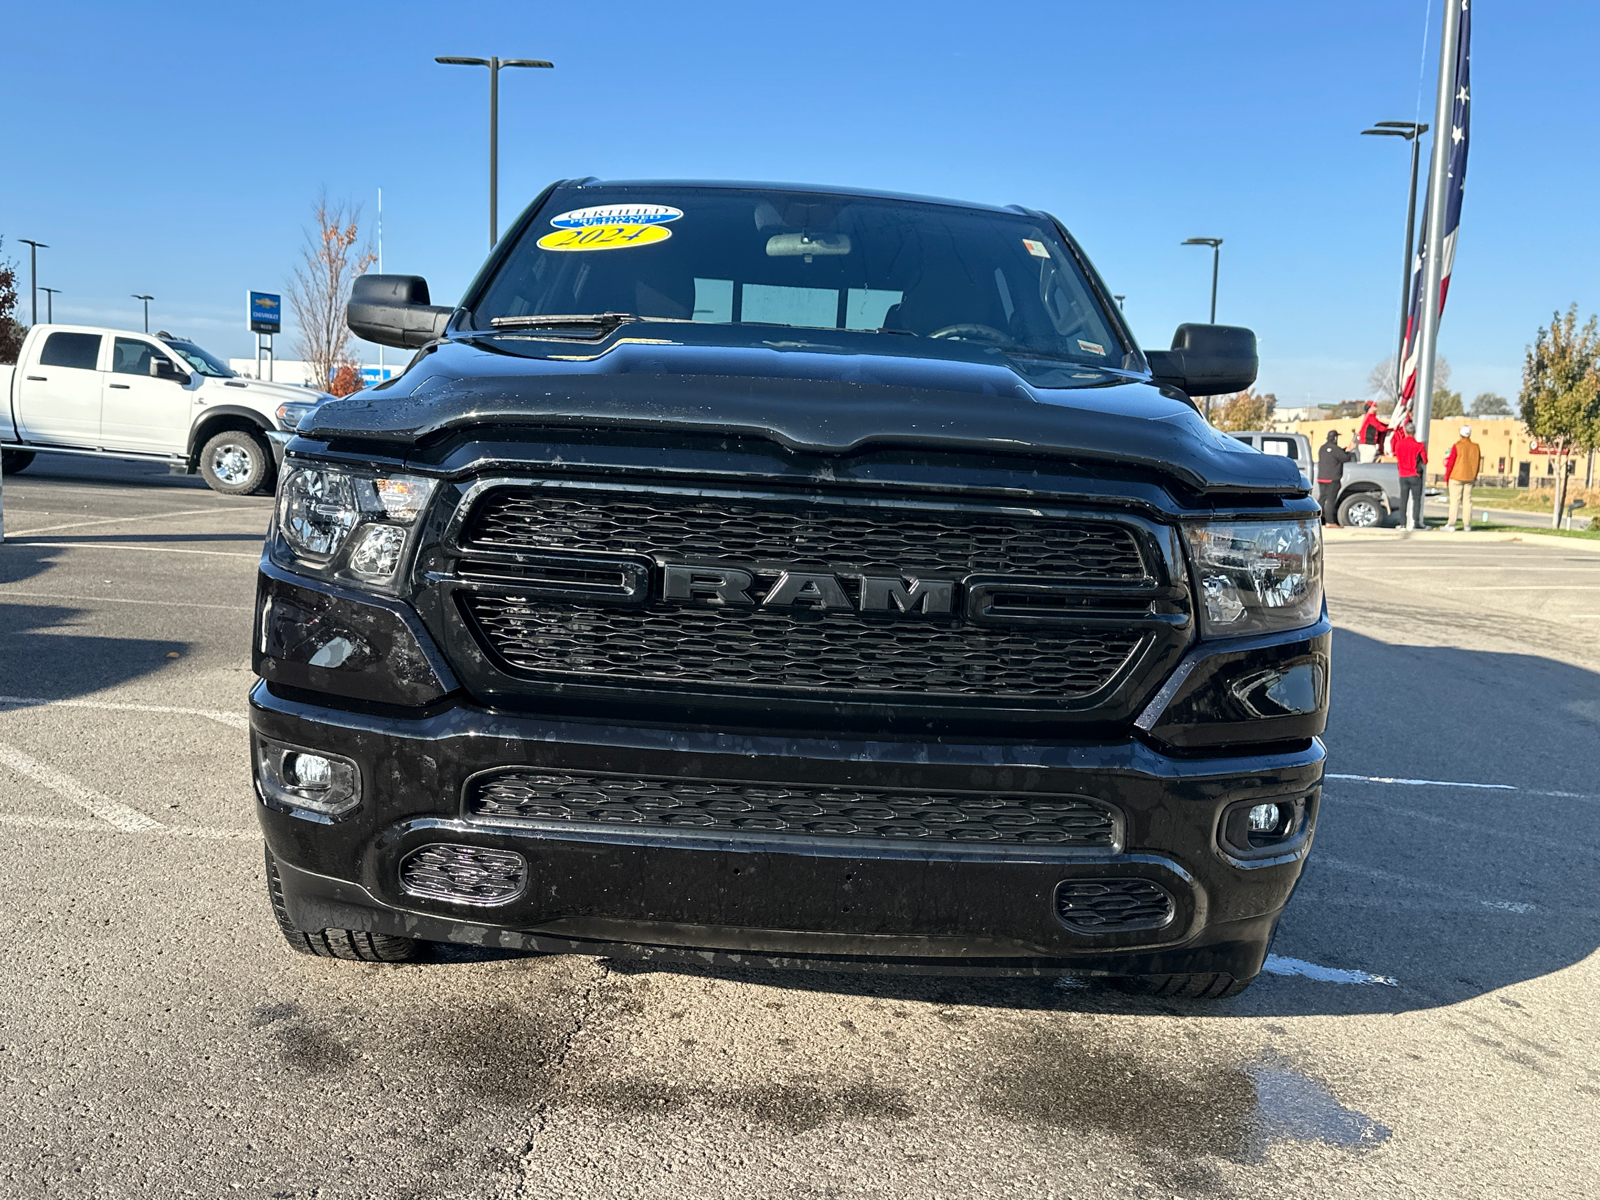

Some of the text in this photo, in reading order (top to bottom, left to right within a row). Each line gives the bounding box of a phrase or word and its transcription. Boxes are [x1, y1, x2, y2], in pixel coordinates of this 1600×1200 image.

[568, 207, 669, 219] CERTIFIED
[554, 226, 650, 247] 2024
[663, 564, 955, 614] RAM
